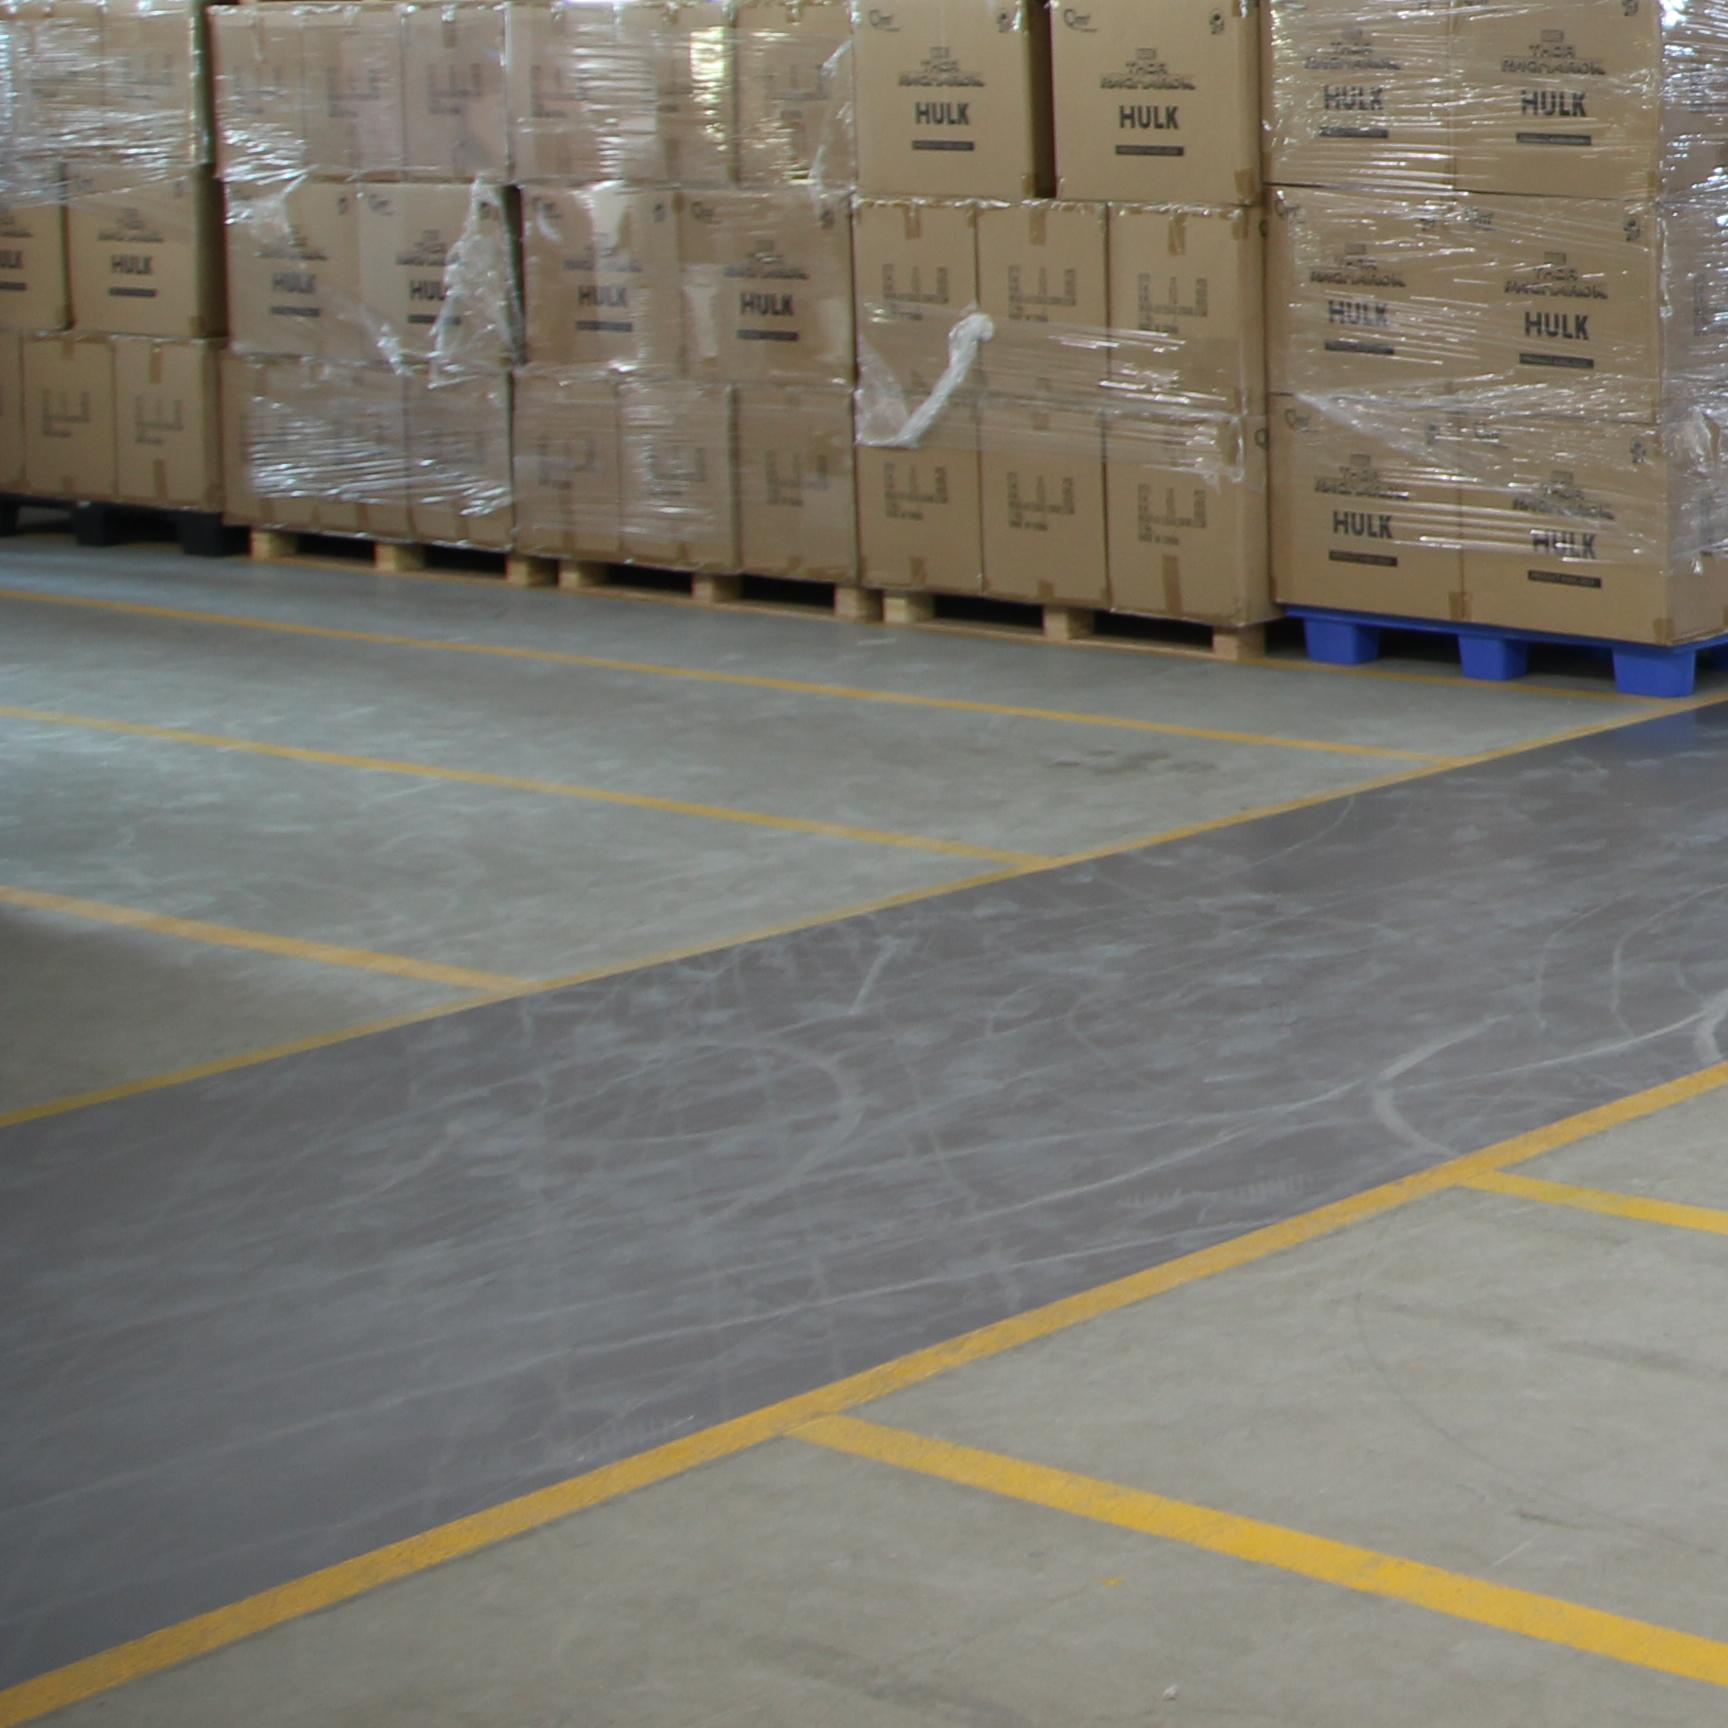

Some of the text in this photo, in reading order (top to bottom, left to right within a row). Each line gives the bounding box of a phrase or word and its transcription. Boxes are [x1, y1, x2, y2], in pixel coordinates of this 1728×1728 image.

[1323, 84, 1385, 111] HULK
[1520, 89, 1588, 117] HULK
[915, 102, 969, 125] HULK
[1119, 105, 1180, 129] HULK
[111, 254, 153, 276] HULK
[272, 272, 316, 295] HULK
[409, 279, 446, 301] HUL
[577, 285, 627, 308] HULK
[741, 293, 795, 317] HULK
[1328, 300, 1389, 326] HULK
[1524, 312, 1590, 341] HULK
[1333, 510, 1394, 539] HULK
[1531, 530, 1598, 559] HULK
